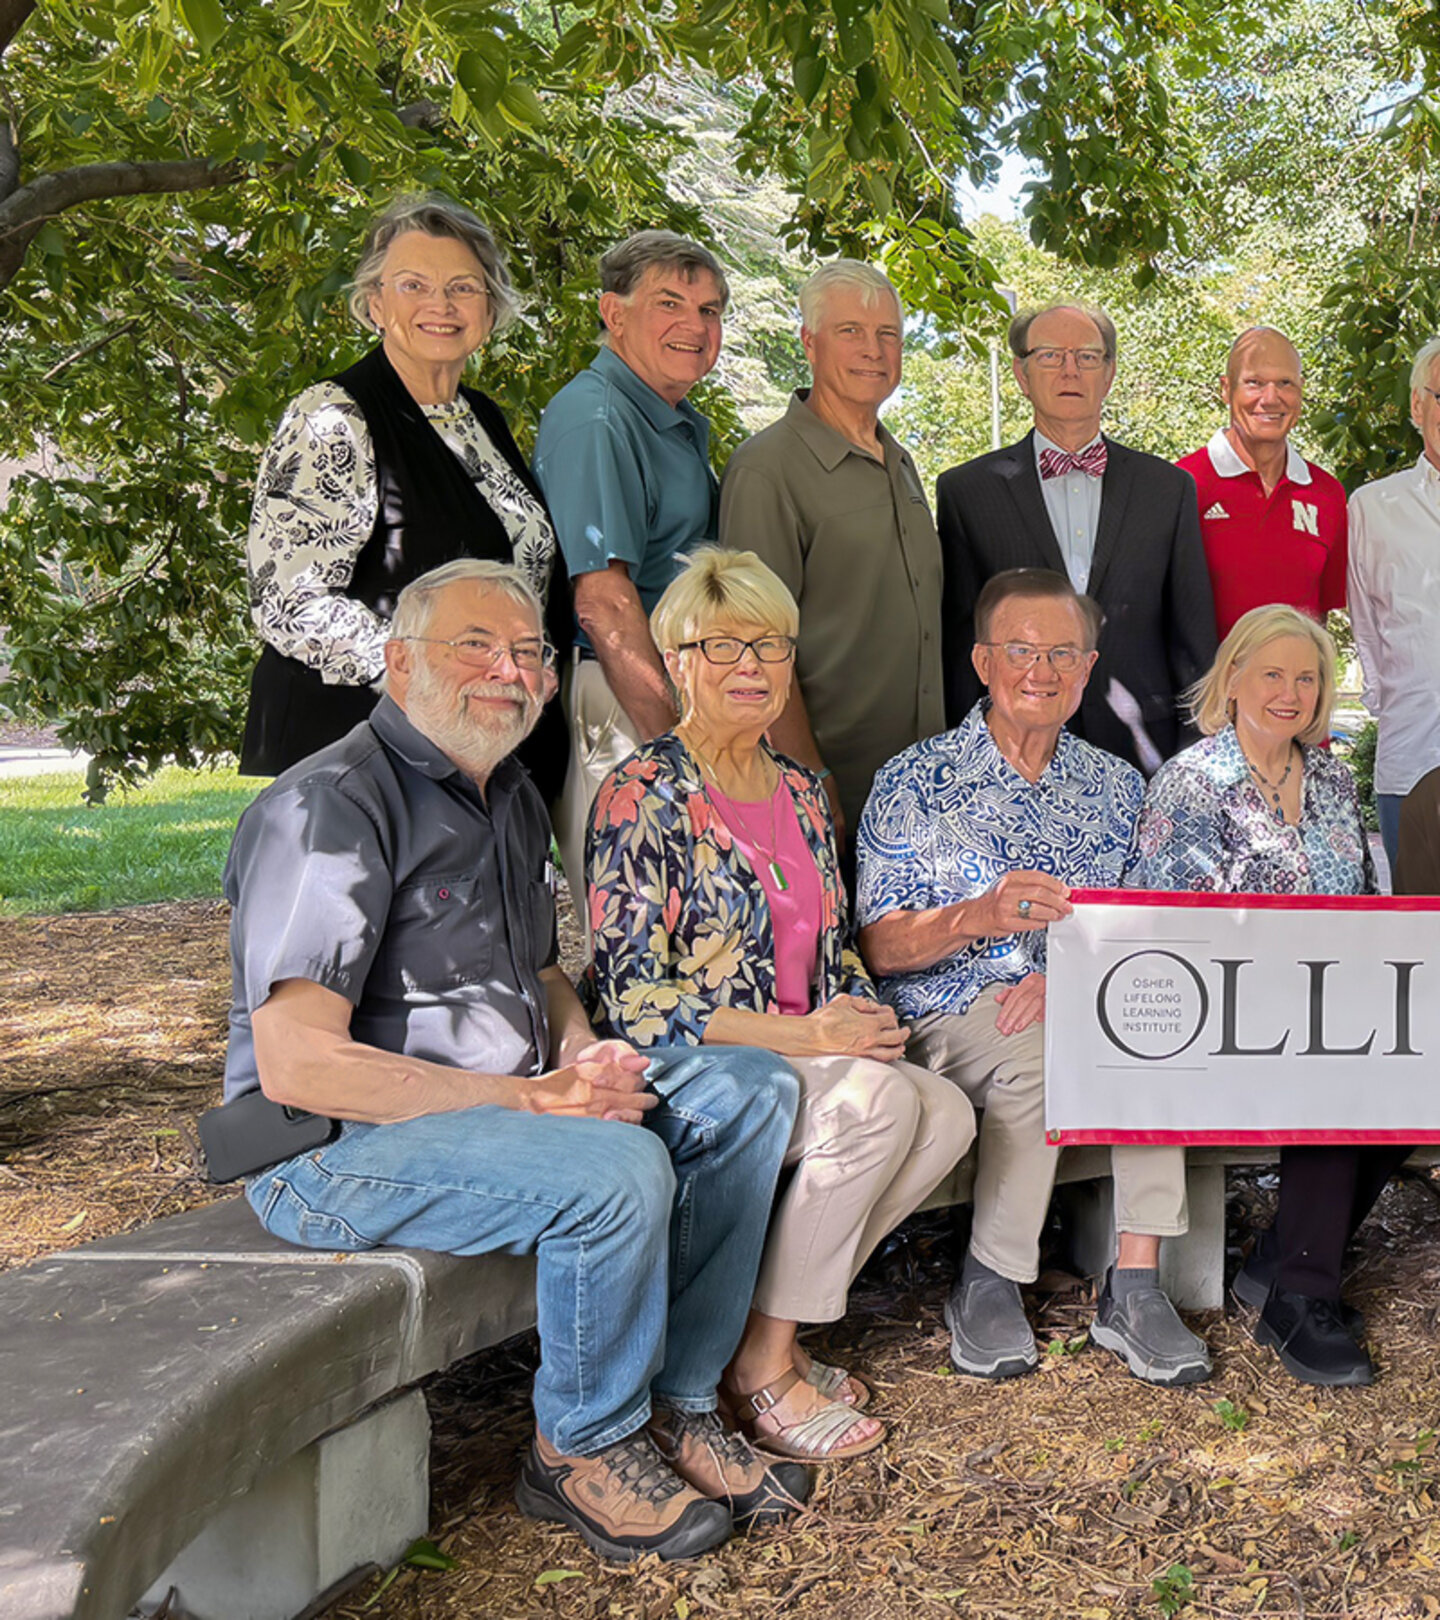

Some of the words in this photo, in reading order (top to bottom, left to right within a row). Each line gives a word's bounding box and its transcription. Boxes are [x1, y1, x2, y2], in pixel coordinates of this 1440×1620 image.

[1291, 499, 1320, 537] N
[1132, 978, 1174, 989] OSHER
[1124, 993, 1182, 1004] LIFELONG
[1097, 949, 1424, 1061] OLLI
[1122, 1007, 1182, 1018] LEARNING
[1122, 1022, 1182, 1033] INSTITUTE
